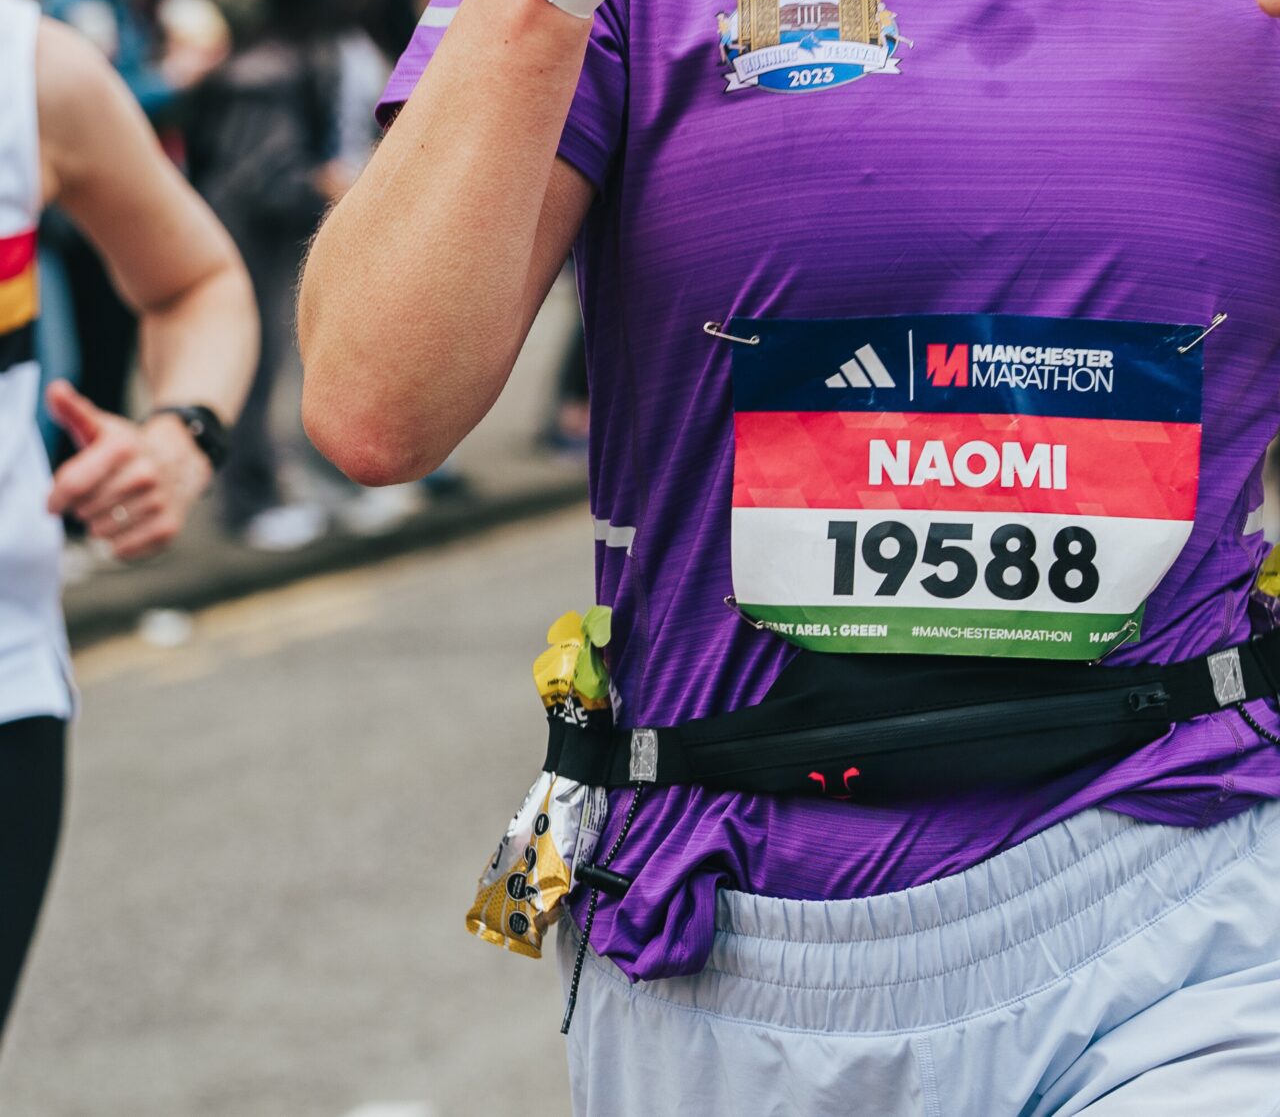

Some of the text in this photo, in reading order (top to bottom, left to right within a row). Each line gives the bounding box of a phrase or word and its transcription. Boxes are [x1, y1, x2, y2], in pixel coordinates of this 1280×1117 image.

[788, 66, 835, 88] 2023
[972, 344, 1114, 368] MANCHESTER
[972, 363, 1115, 393] MARATHON
[868, 439, 1067, 490] NAOMI
[827, 520, 1100, 603] 19588
[796, 624, 831, 636] AREA
[839, 624, 888, 637] GREEN
[911, 626, 1073, 643] #MANCHESTERMARATHON
[1089, 632, 1100, 643] 14
